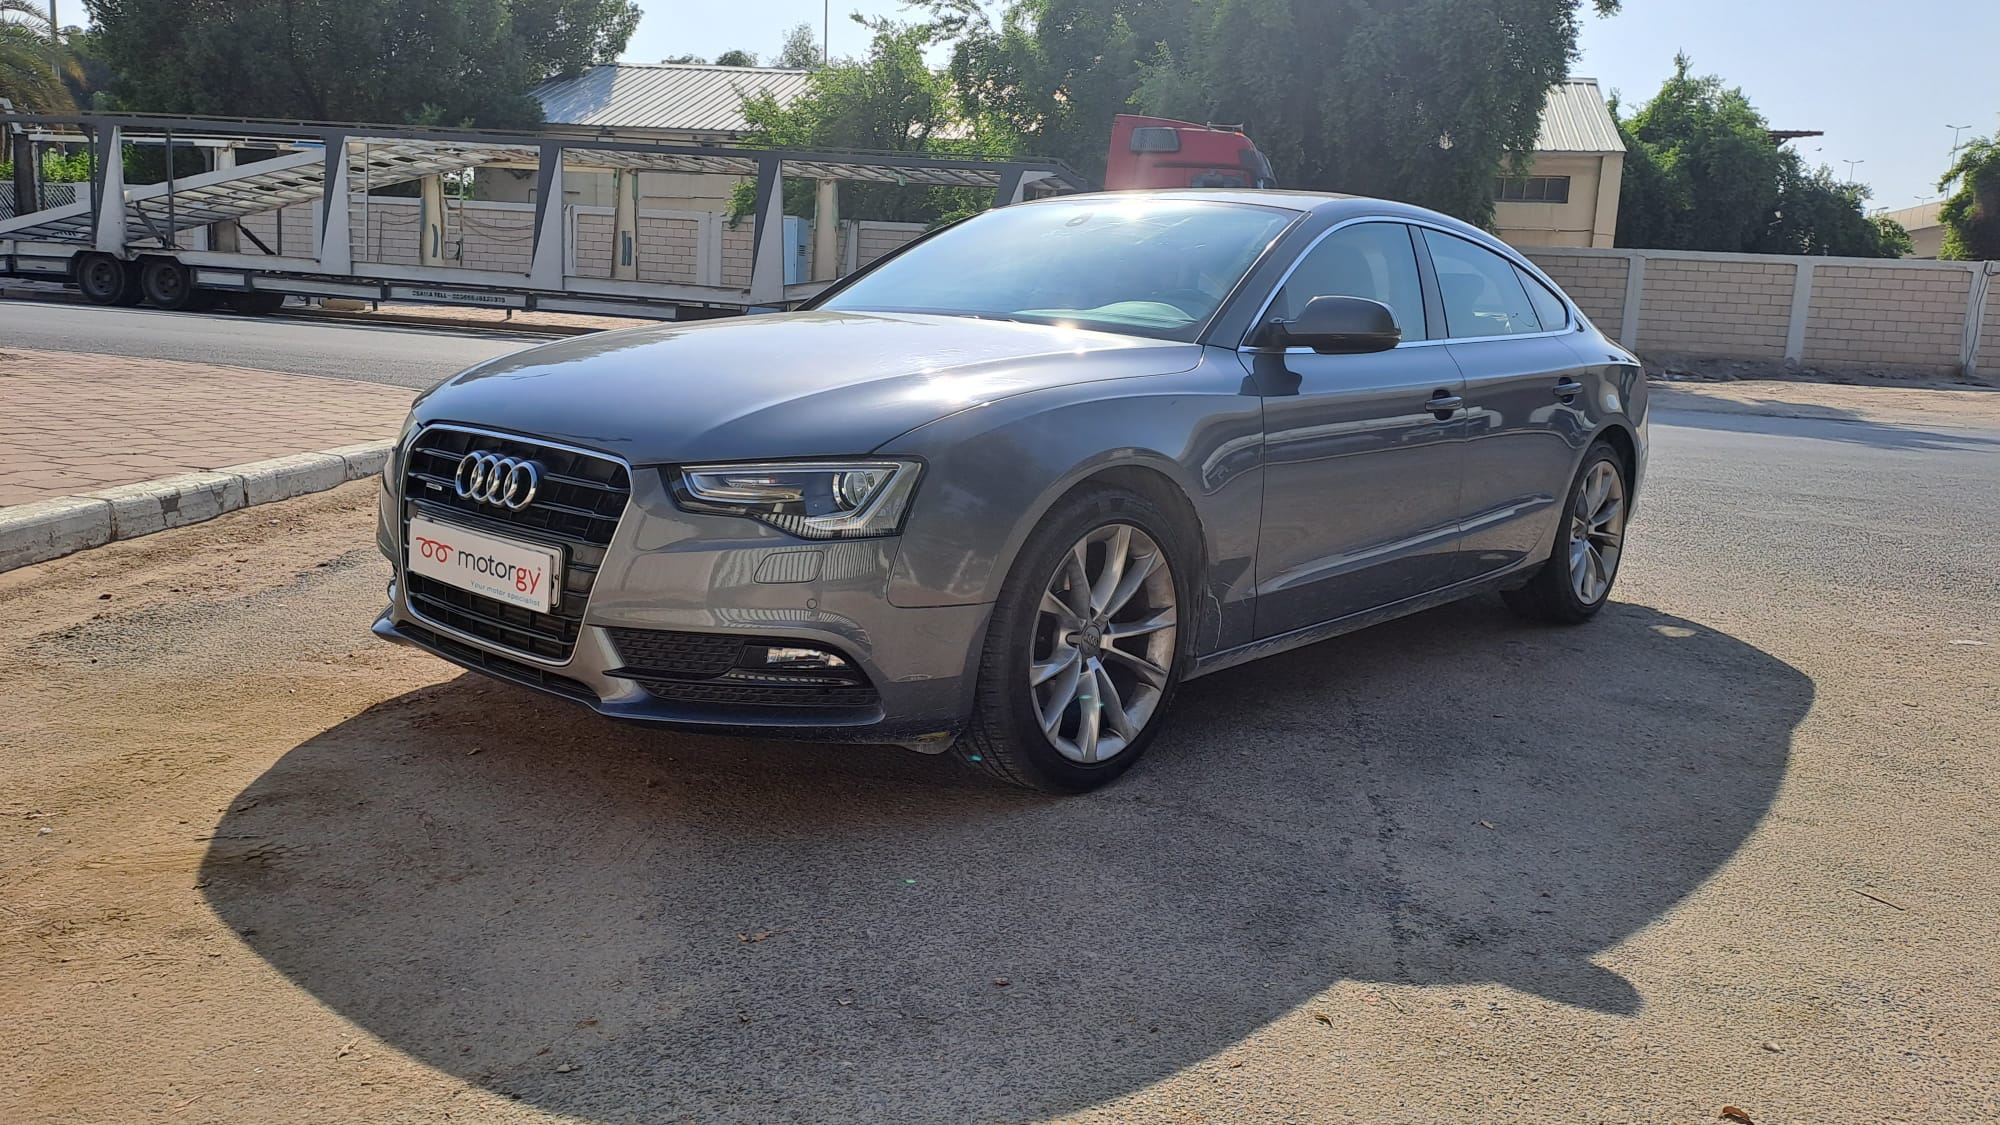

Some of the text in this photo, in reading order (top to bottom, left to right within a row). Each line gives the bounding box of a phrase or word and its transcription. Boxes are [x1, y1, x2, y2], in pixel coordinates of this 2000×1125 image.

[458, 550, 541, 595] motorgy
[471, 580, 540, 607] Your motor specialist
